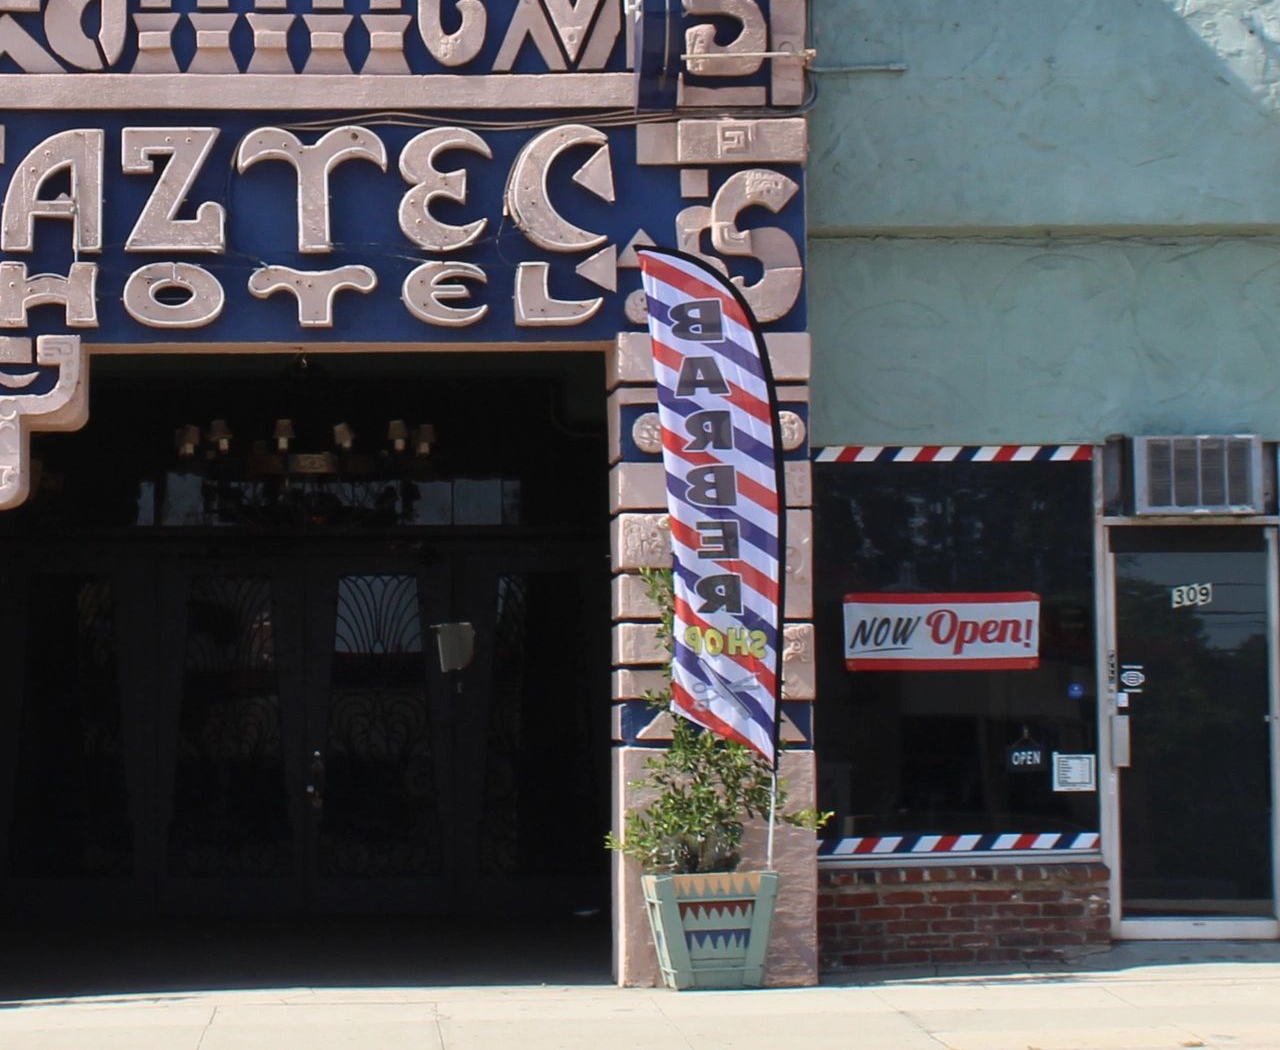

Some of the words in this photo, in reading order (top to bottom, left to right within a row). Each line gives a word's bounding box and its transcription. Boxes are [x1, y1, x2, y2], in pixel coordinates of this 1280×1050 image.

[1, 123, 609, 253] AZTEC
[1174, 587, 1210, 605] 309
[849, 616, 921, 649] NOW
[925, 609, 1033, 656] Open!
[1011, 751, 1041, 765] OPEN
